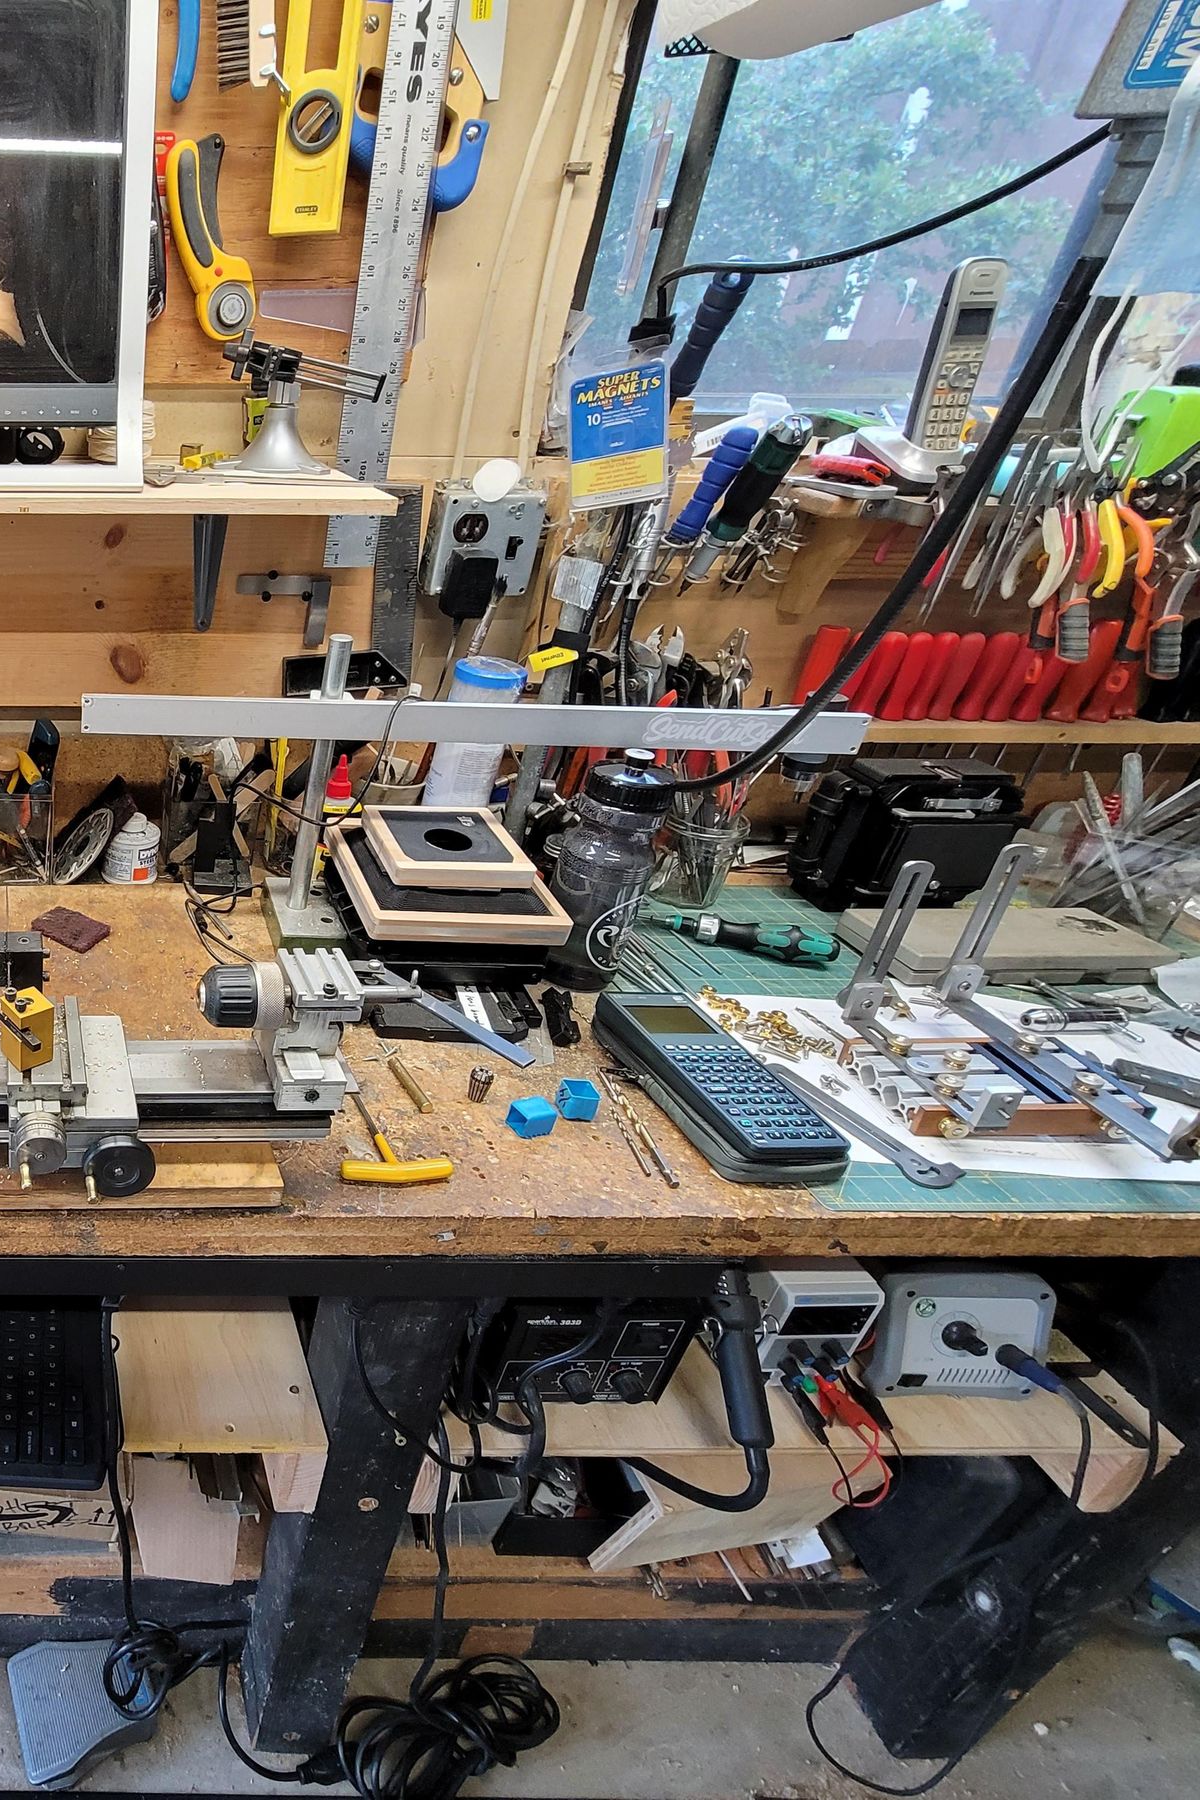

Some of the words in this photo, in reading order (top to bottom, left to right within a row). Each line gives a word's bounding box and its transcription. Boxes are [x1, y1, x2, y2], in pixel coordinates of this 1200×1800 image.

[393, 51, 402, 66] 16
[431, 53, 440, 68] 20
[388, 89, 397, 104] 15
[426, 90, 435, 104] 21
[384, 126, 392, 140] 14
[421, 127, 430, 142] 22
[379, 162, 388, 176] 13
[416, 163, 425, 177] 23
[375, 197, 384, 210] 12
[411, 198, 420, 212] 24
[392, 215, 400, 234] 1896
[407, 232, 415, 246] 25
[367, 265, 375, 277] 10
[402, 266, 411, 279] 26
[398, 298, 406, 312] 27
[393, 330, 402, 343] 28
[597, 370, 641, 389] SUPER
[576, 376, 662, 404] MAGNETS
[586, 413, 601, 427] 10
[643, 713, 804, 746] SendCutSe
